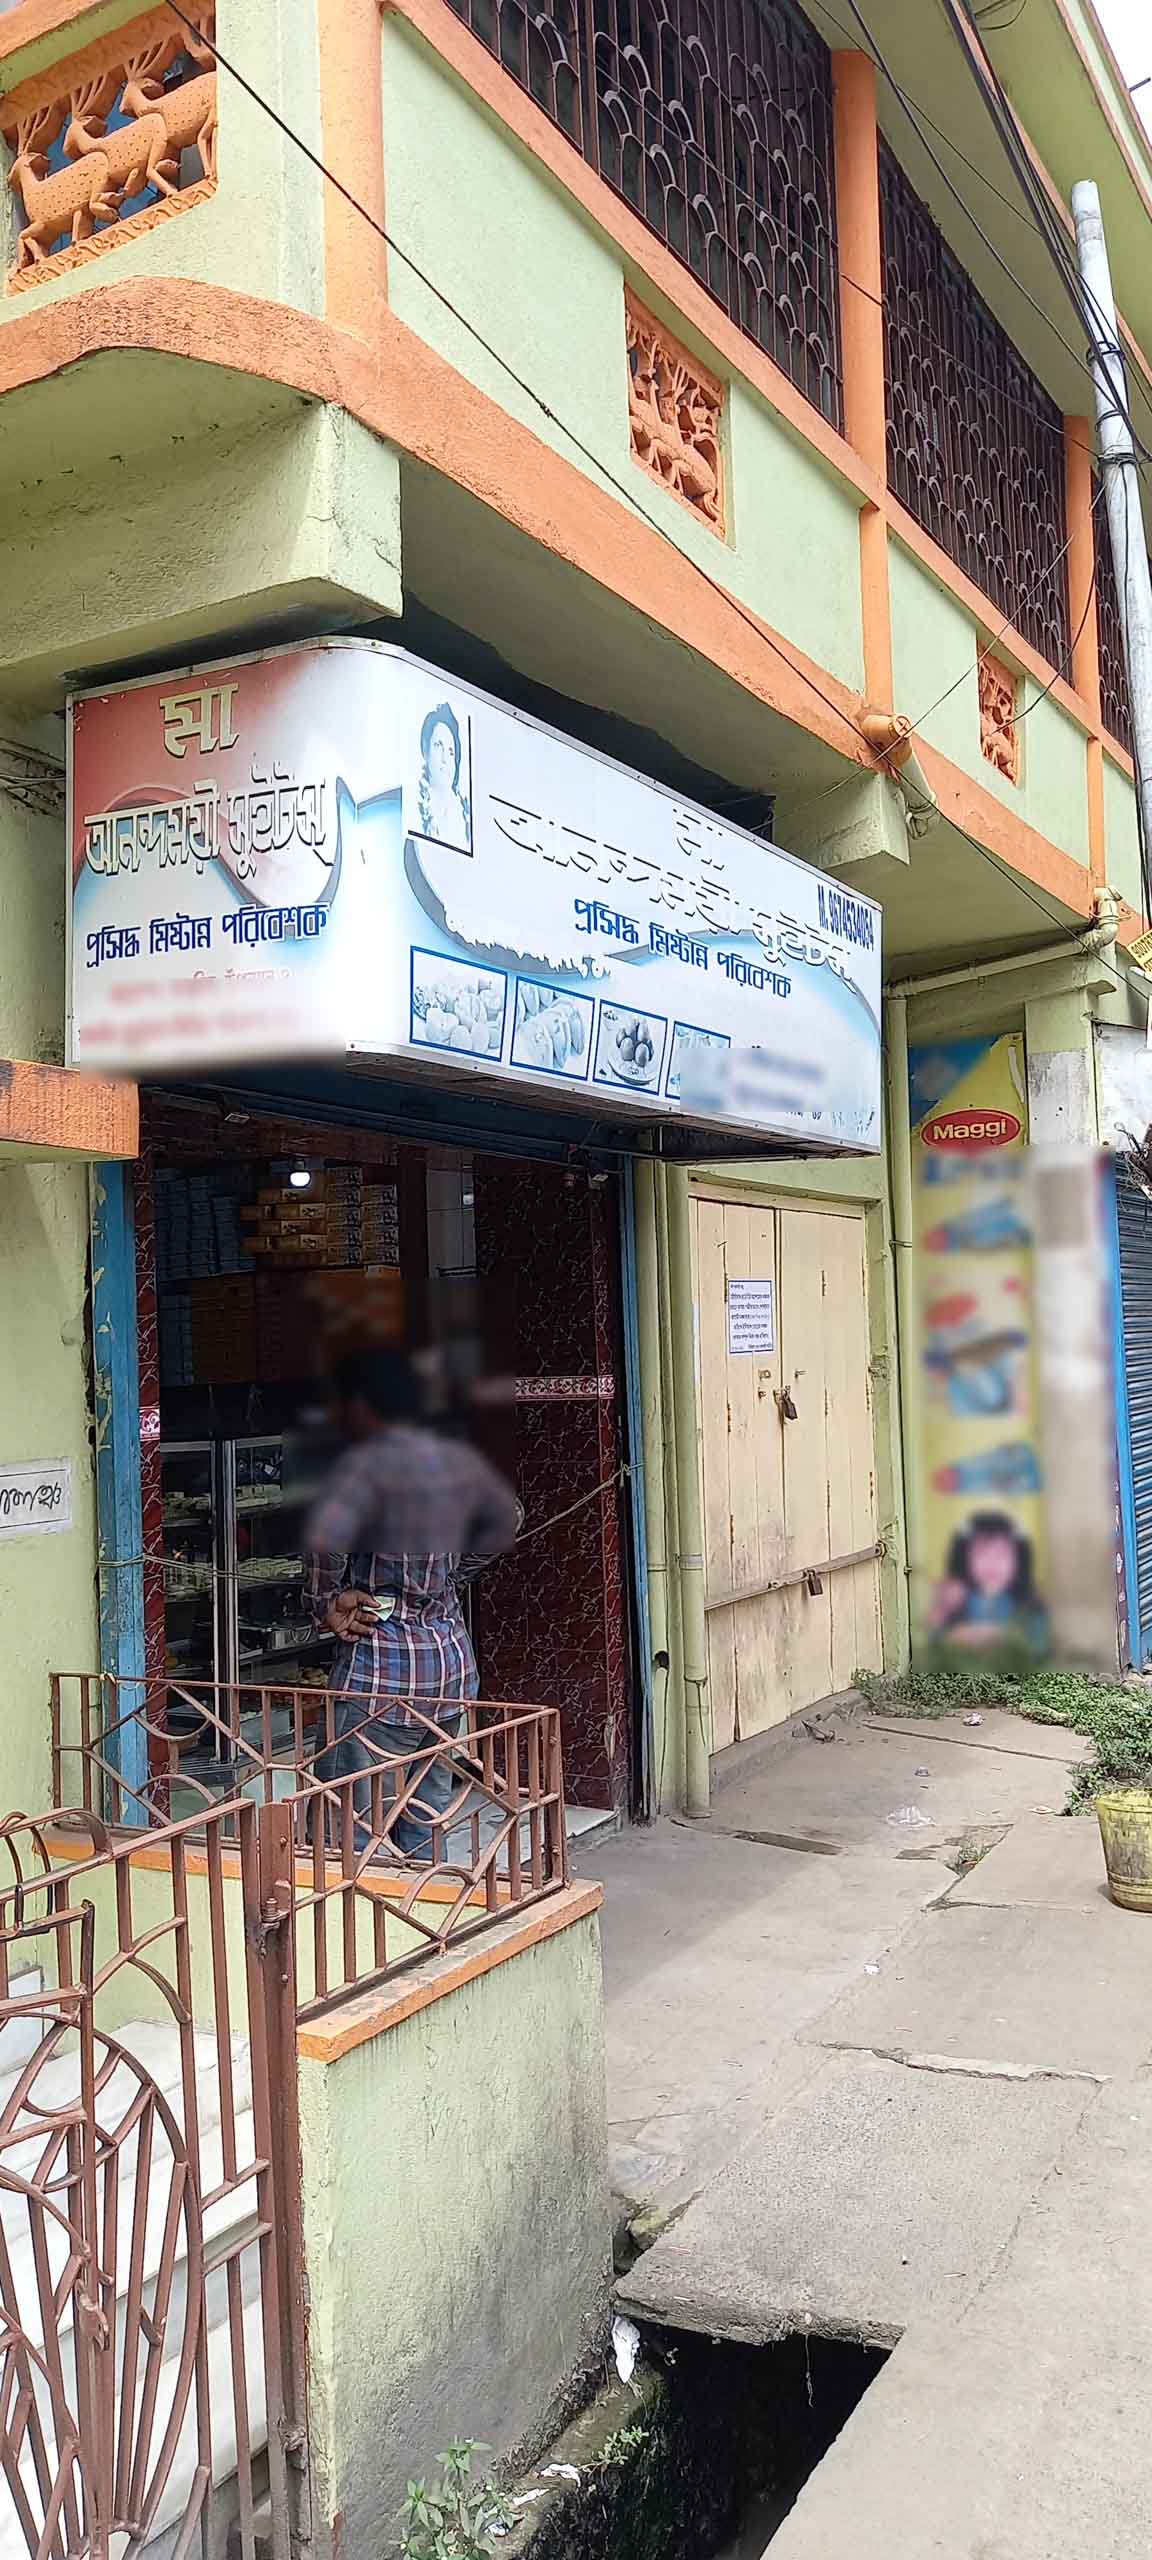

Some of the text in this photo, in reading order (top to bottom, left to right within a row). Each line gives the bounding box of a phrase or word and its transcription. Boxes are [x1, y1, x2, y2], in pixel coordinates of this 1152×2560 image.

[160, 683, 240, 759] মা
[86, 925, 142, 968] প্রসিদ্ধ
[222, 903, 328, 952] পরিবেশক
[573, 898, 640, 946] প্রসিদ্ধ
[716, 952, 793, 1000] পরিবেশক
[933, 1118, 1007, 1140] Maggi
